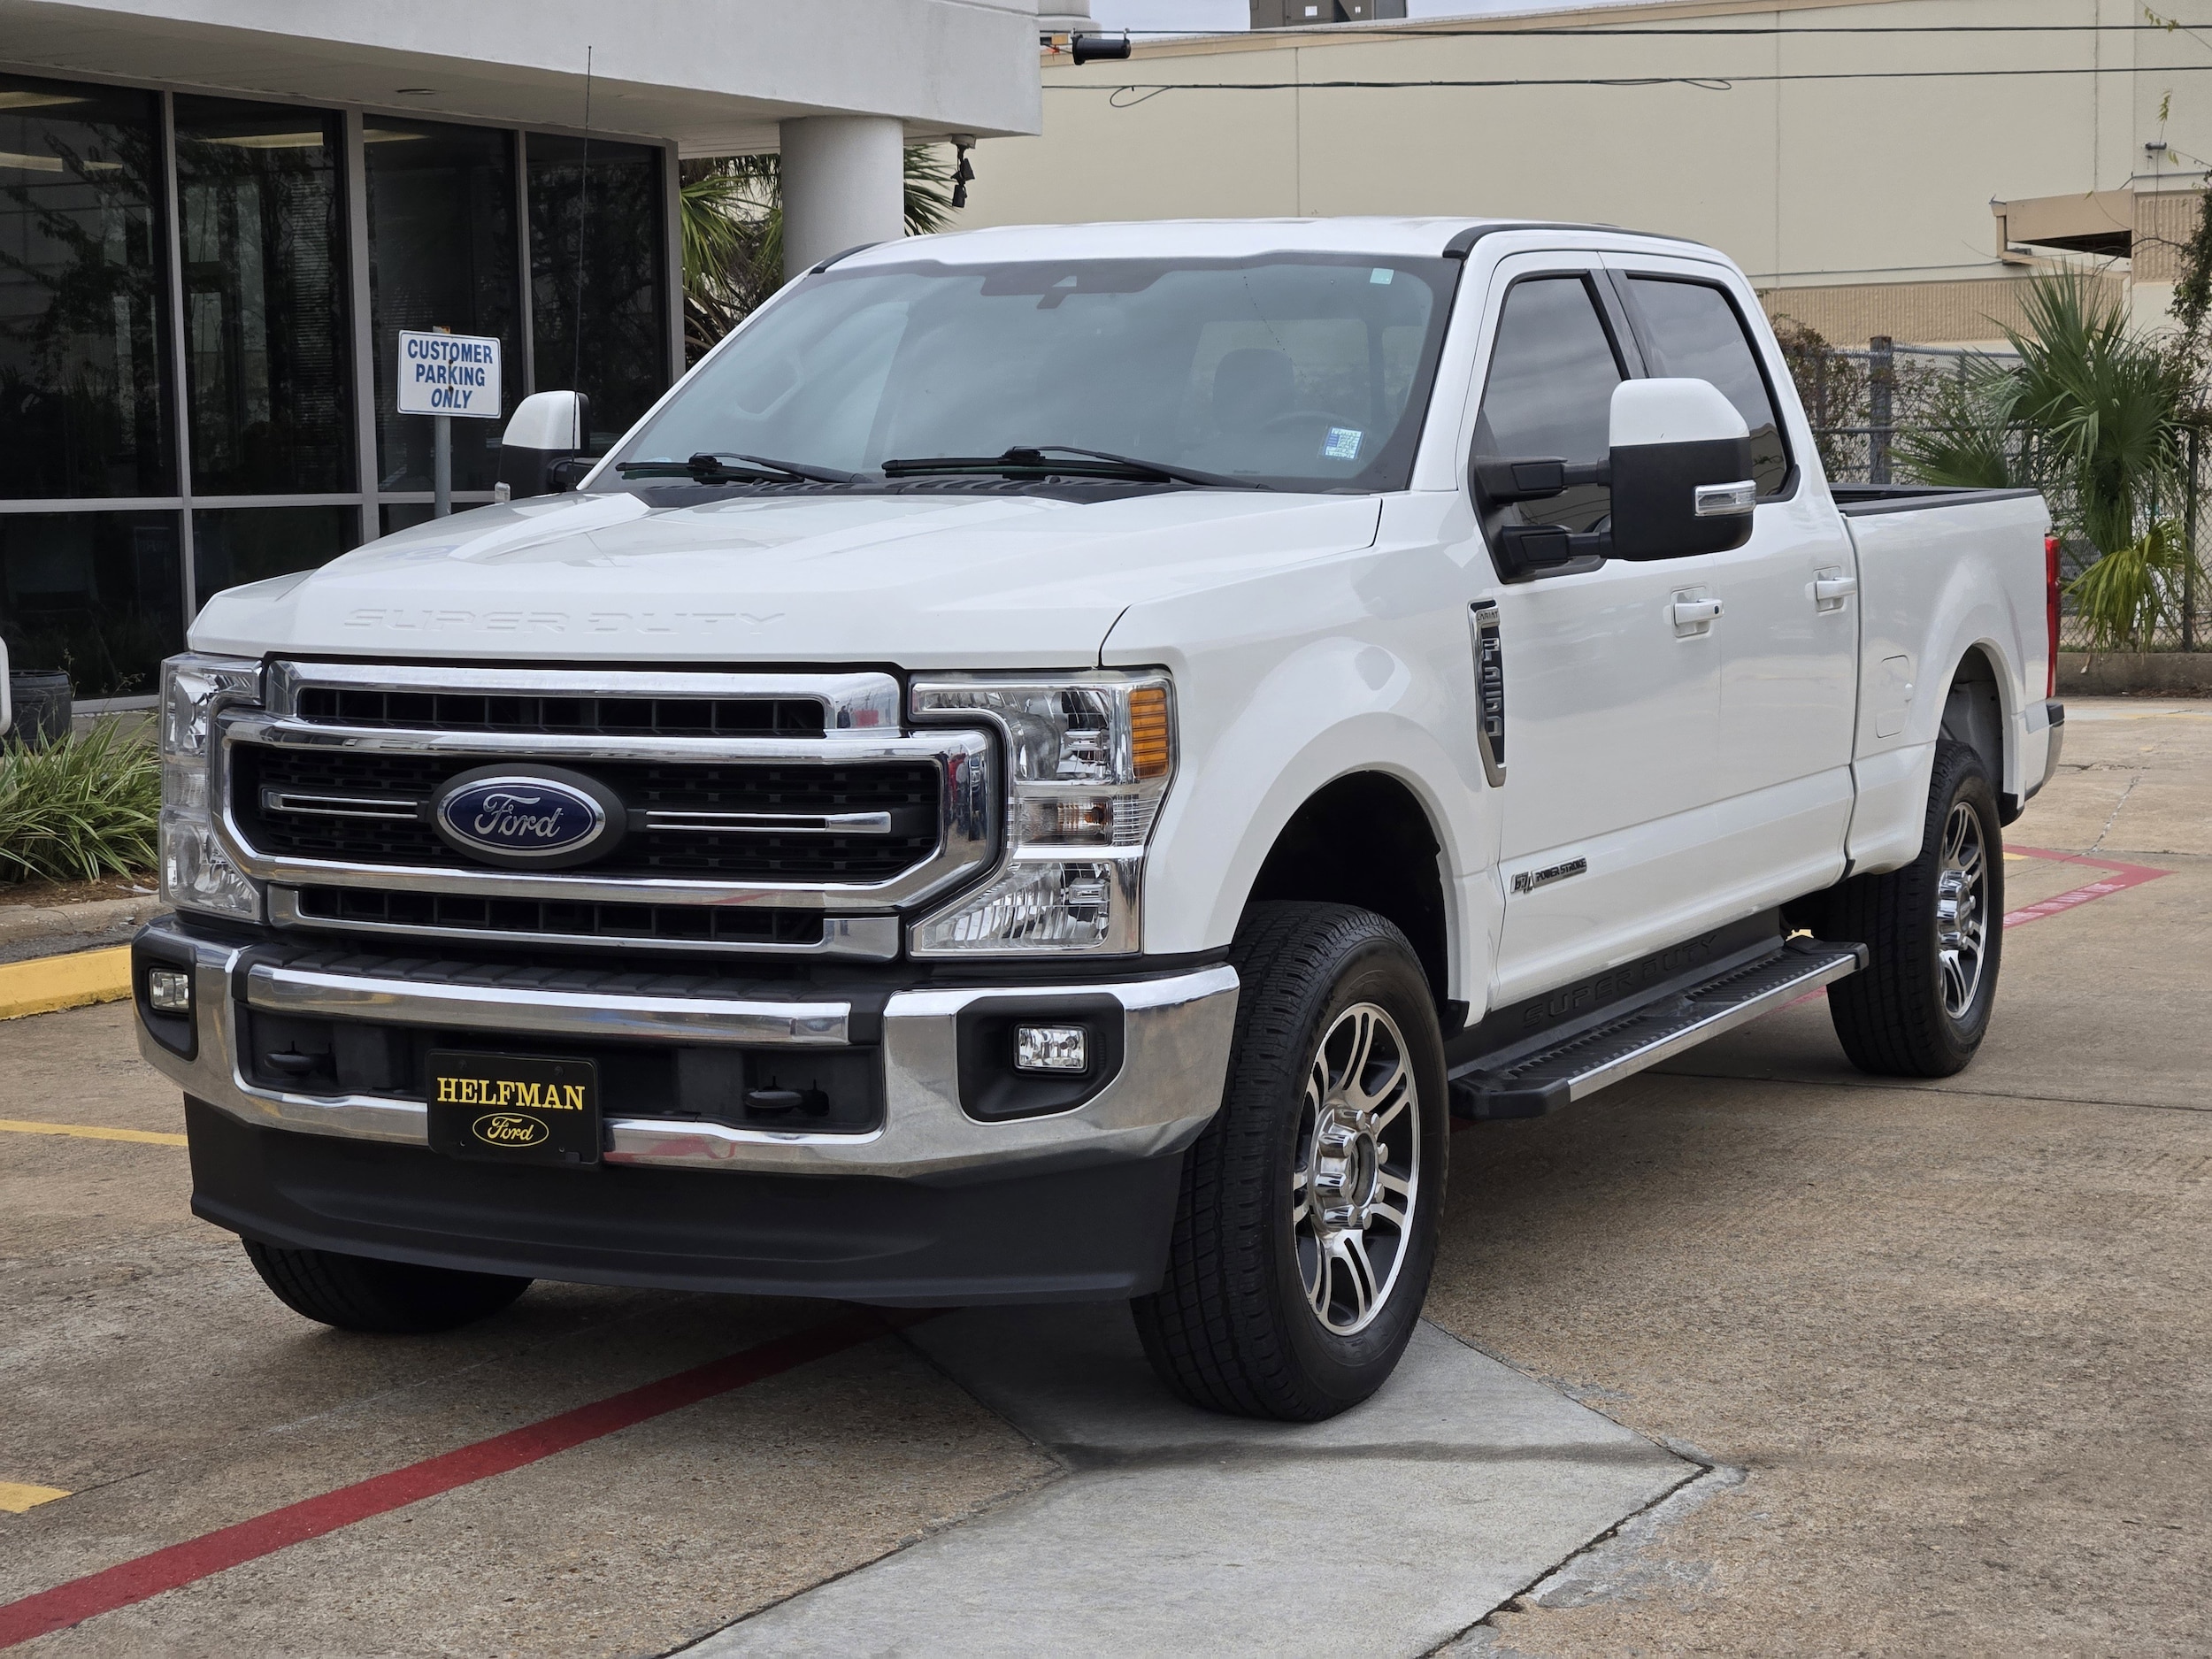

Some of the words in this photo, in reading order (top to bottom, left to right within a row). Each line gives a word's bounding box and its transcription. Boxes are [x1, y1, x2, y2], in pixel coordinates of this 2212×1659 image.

[408, 339, 493, 364] CUSTOMER
[416, 363, 485, 387] PARKING
[431, 388, 472, 409] ONLY
[343, 608, 570, 634] SUPER
[583, 612, 786, 634] DUTY
[1478, 611, 1498, 621] LARIAT
[474, 793, 565, 838] Ford
[1535, 866, 1560, 883] POWER
[1560, 857, 1586, 875] STROKE
[1524, 971, 1633, 1029] SUPER
[1642, 934, 1717, 980] DUTY
[437, 1077, 585, 1110] HELFMAN
[488, 1116, 534, 1141] Ford
